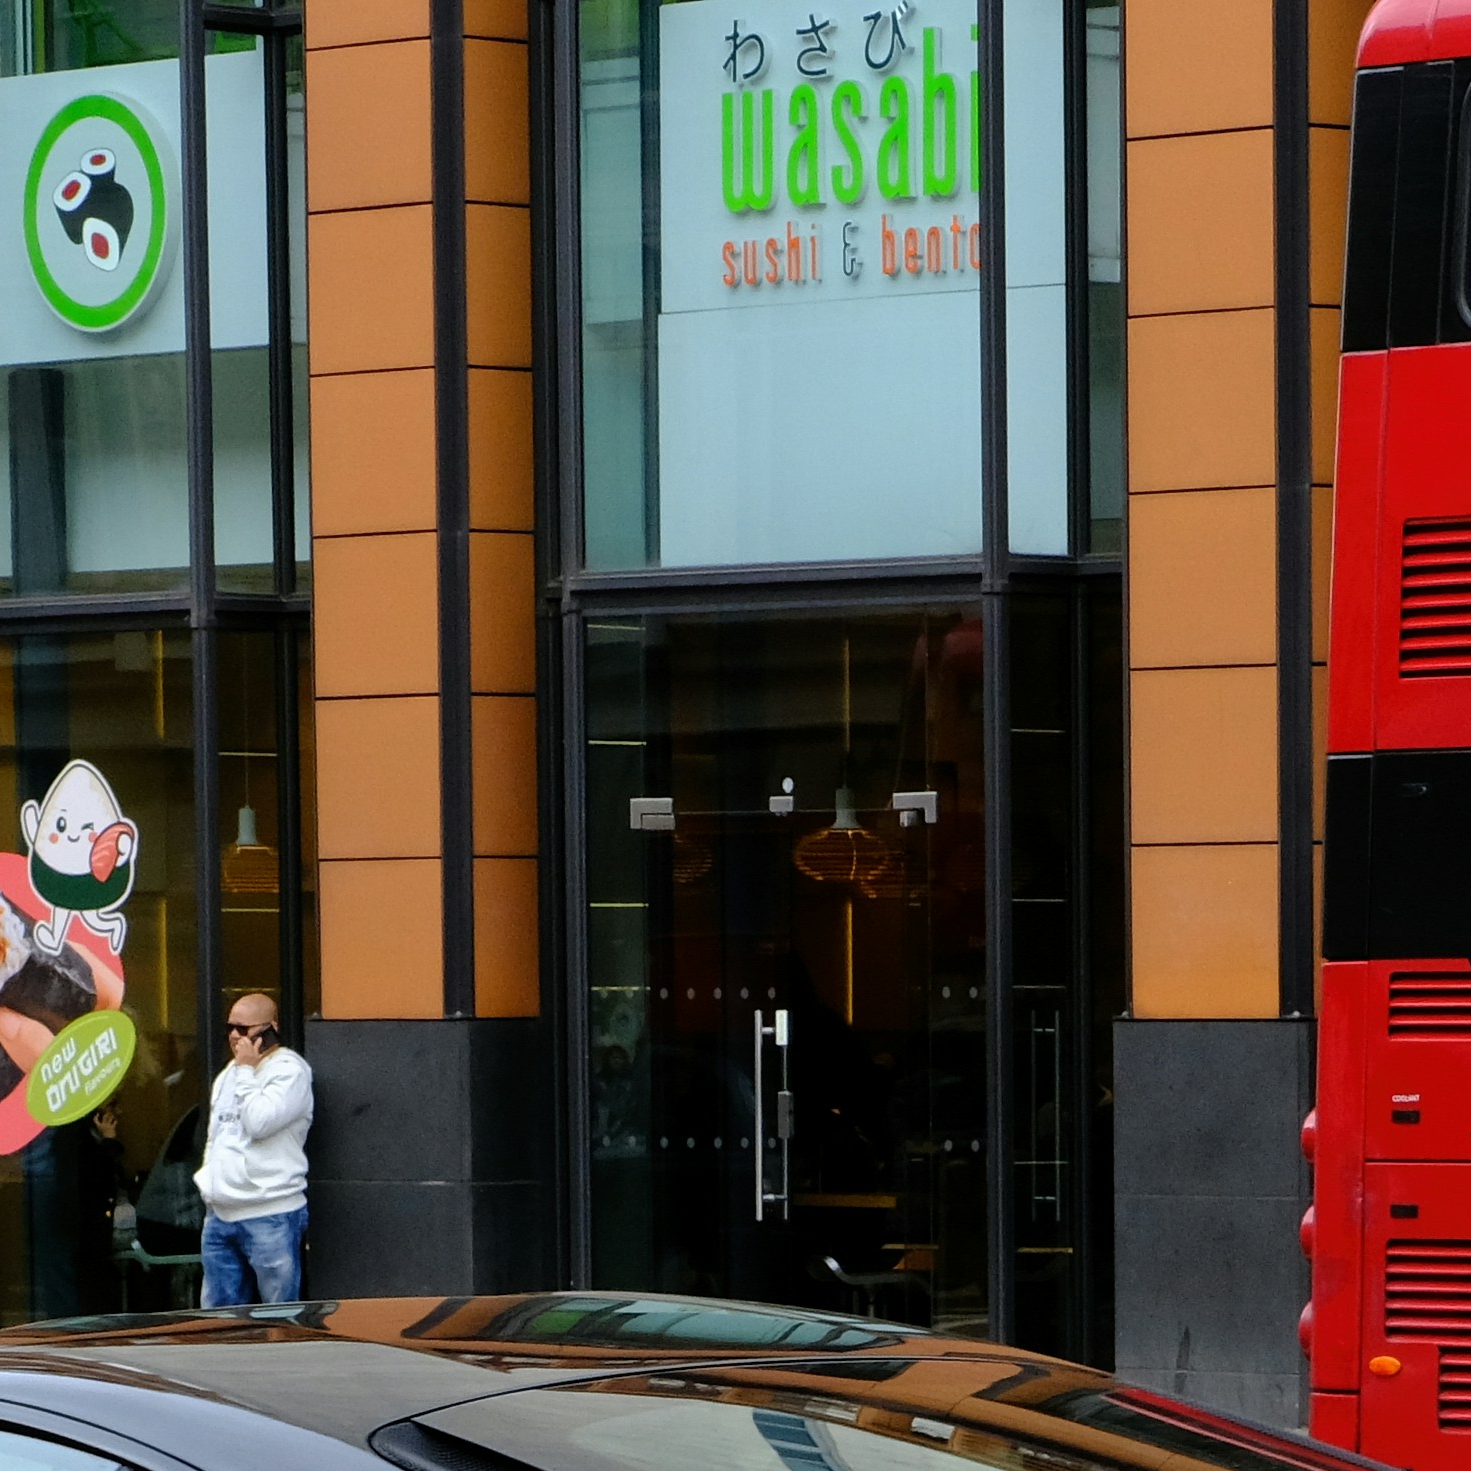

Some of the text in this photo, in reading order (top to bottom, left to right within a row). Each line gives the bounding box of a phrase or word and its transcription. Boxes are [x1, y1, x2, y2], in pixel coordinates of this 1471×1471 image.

[721, 24, 979, 213] wasabi
[722, 221, 818, 287] sushi
[842, 222, 857, 276] &
[41, 1037, 76, 1084] new
